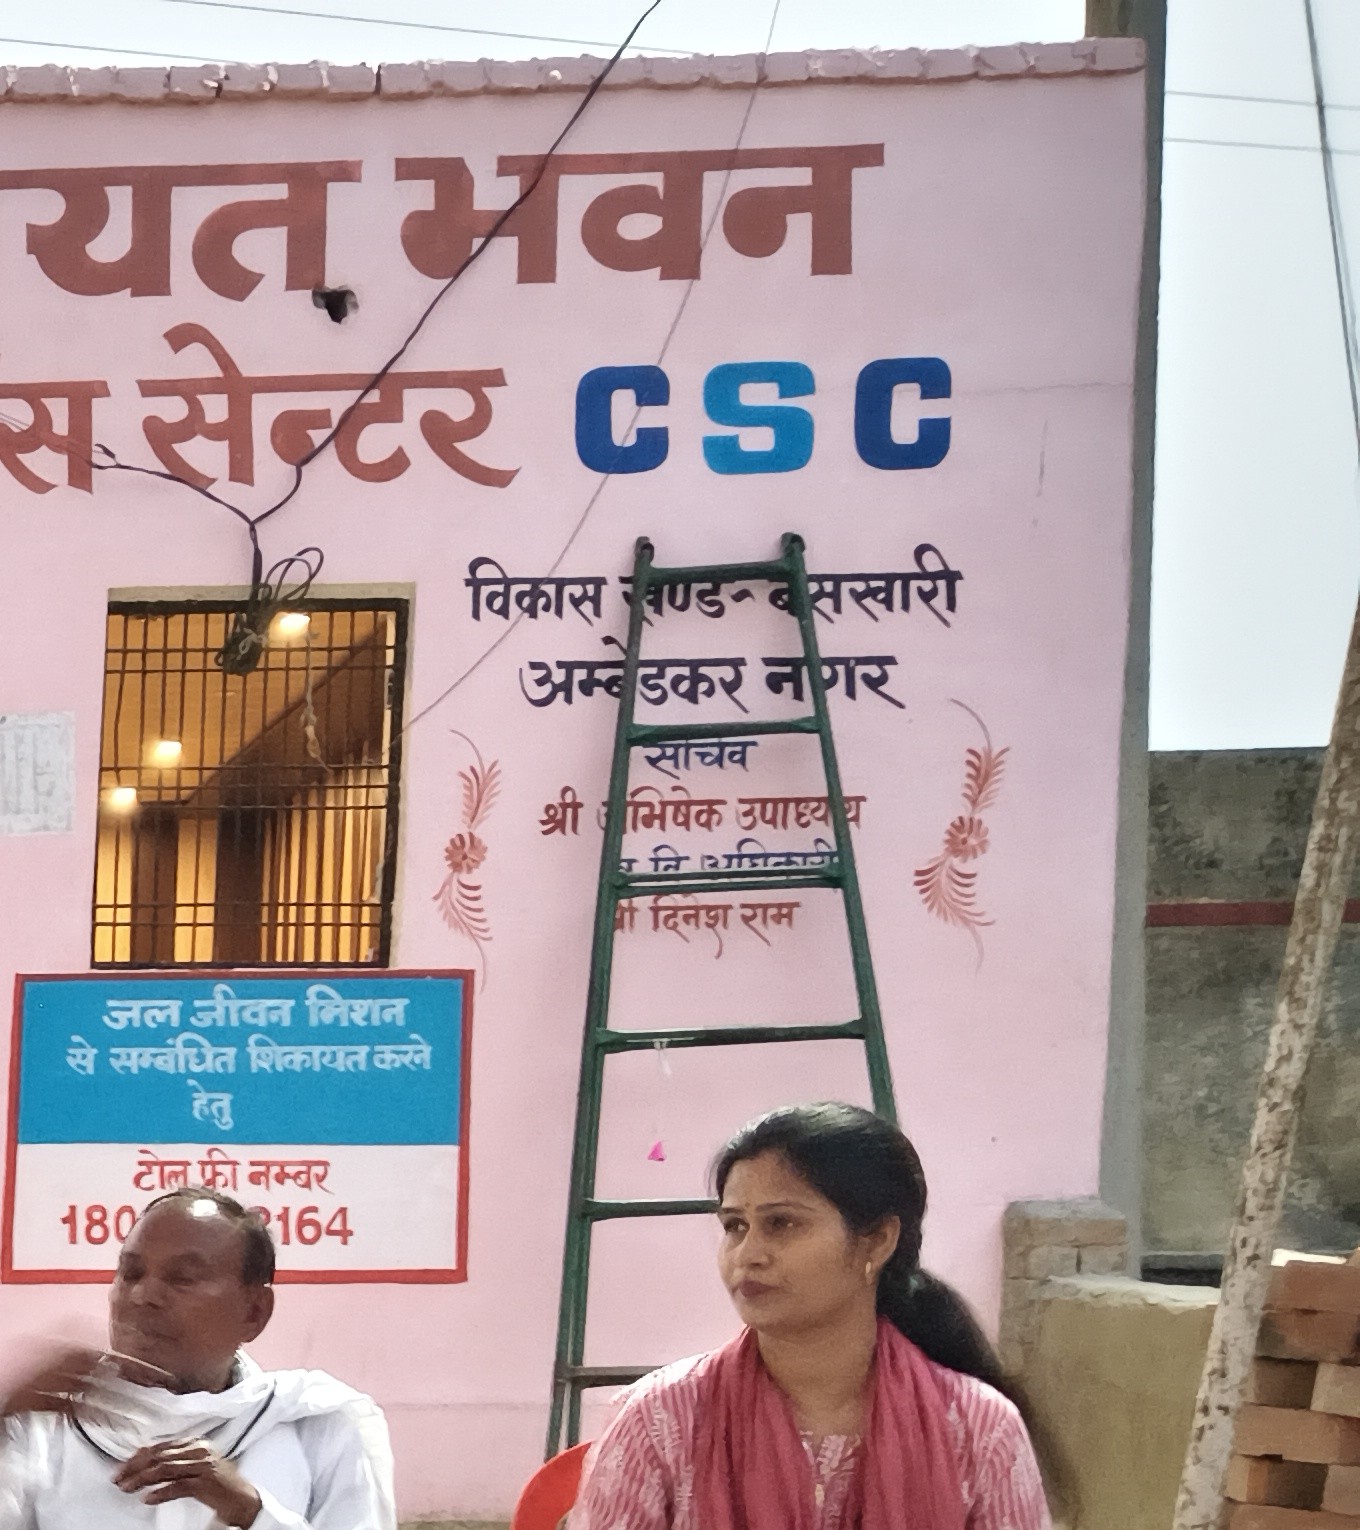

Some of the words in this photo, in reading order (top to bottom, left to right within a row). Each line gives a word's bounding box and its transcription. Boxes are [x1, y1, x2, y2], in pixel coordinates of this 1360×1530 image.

[394, 143, 885, 284] भवन
[135, 322, 521, 489] सेन्टर
[574, 356, 952, 475] CSC
[464, 556, 608, 627] विकास
[538, 785, 584, 836] श्री
[740, 901, 801, 946] राम
[102, 999, 182, 1030] जल
[190, 983, 295, 1028] जीवन
[305, 984, 410, 1027] मिशन
[66, 1035, 98, 1075] से
[247, 1033, 369, 1074] शिकायत
[186, 1079, 234, 1131] हेतु
[247, 1160, 335, 1195] नम्बर
